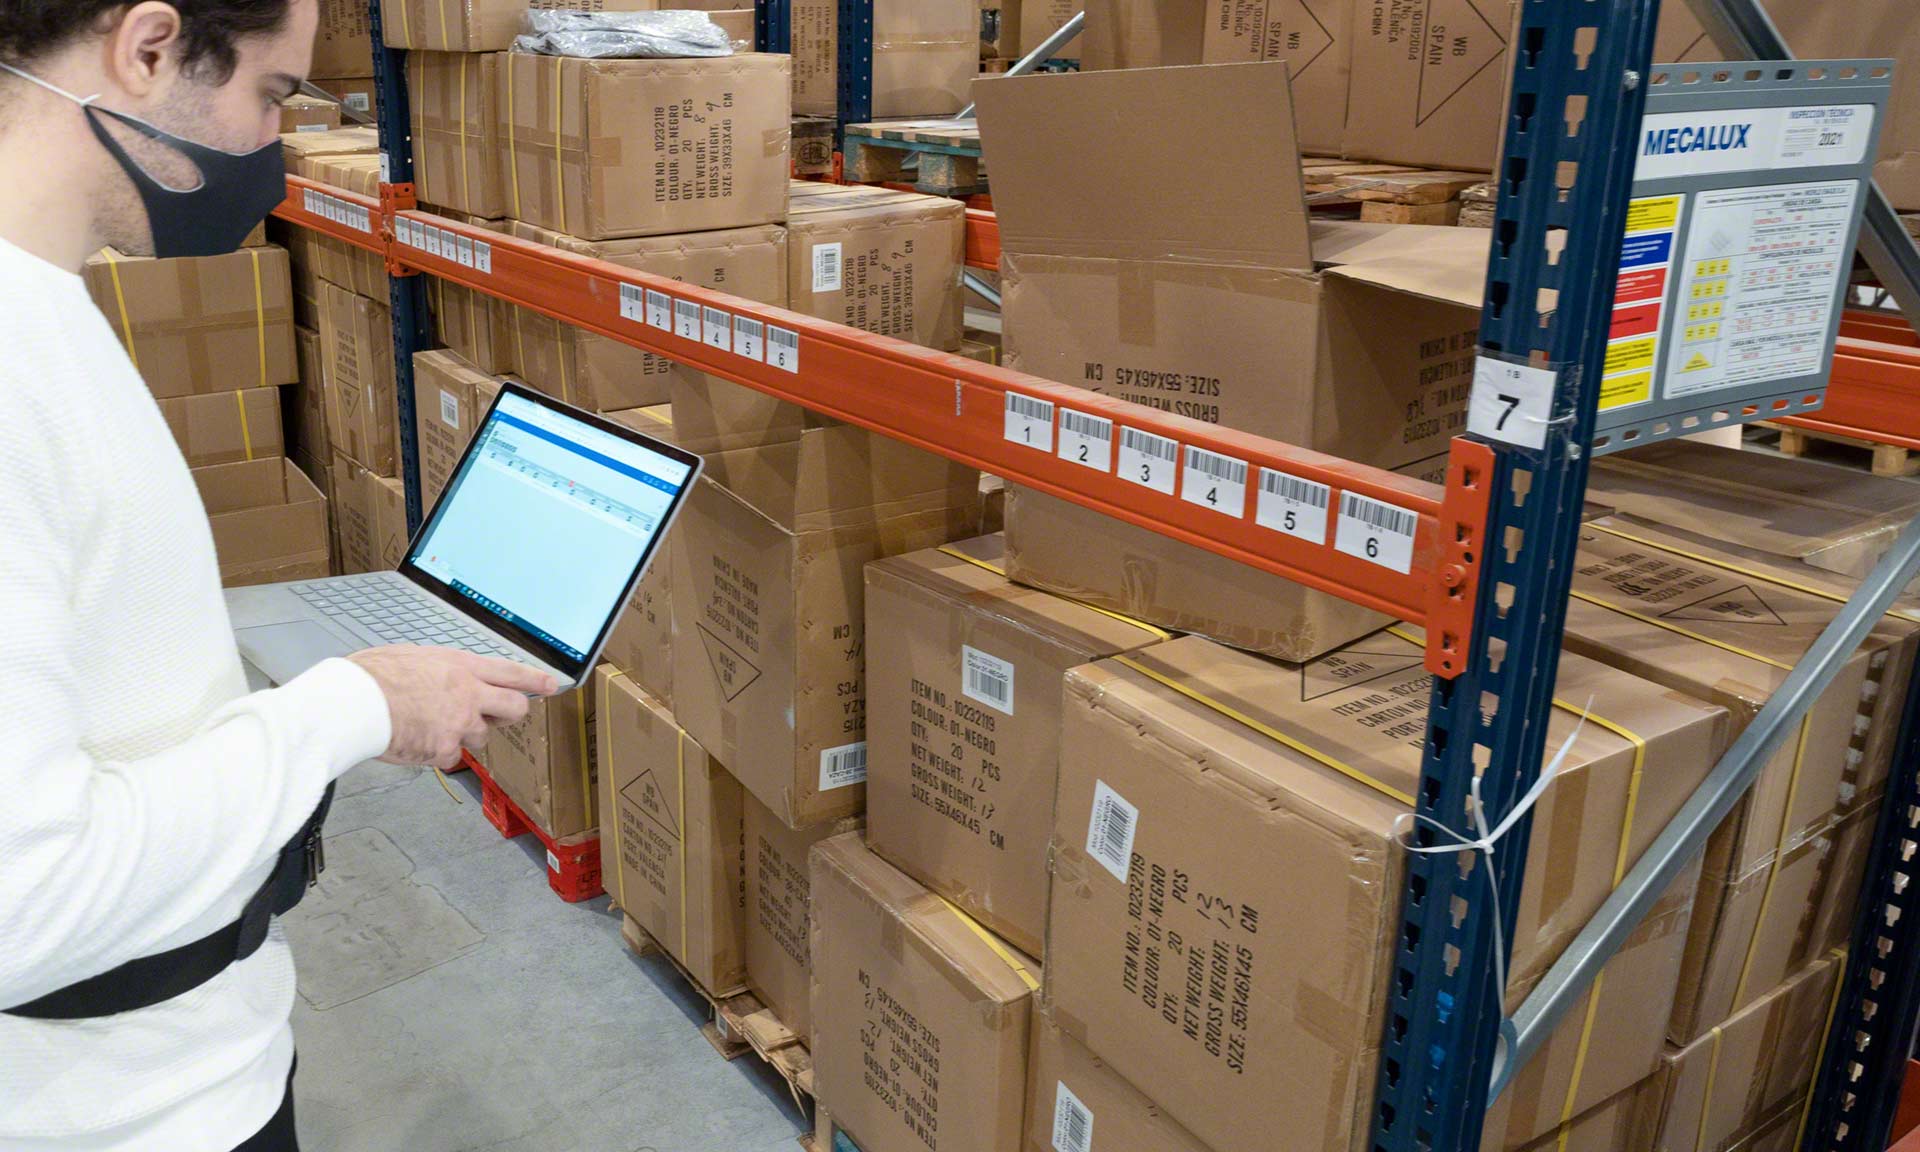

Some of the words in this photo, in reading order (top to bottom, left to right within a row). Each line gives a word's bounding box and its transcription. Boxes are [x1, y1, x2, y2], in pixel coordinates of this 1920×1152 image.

[1267, 22, 1282, 58] SPAIN
[1288, 32, 1300, 50] WB
[1429, 26, 1446, 66] SPAIN
[1453, 36, 1468, 56] WB
[682, 98, 692, 118] PCS
[723, 92, 733, 108] CM
[654, 106, 665, 152] 10232118
[668, 104, 679, 154] 01-NEGRO
[1643, 124, 1752, 156] MECALUX
[682, 140, 692, 152] 20
[656, 178, 665, 202] ITEM
[696, 180, 706, 199] NET
[708, 166, 720, 198] GROSS
[870, 248, 879, 266] PCS
[905, 240, 913, 254] CM
[714, 268, 724, 282] CM
[869, 284, 878, 296] 20
[628, 306, 634, 318] 1
[656, 314, 661, 326] 2
[892, 303, 902, 334] GROSS
[685, 324, 690, 336] 3
[714, 332, 720, 344] 4
[881, 320, 890, 336] NET
[745, 342, 750, 355] 5
[778, 352, 785, 366] 6
[1084, 362, 1103, 381] CM
[1116, 368, 1181, 391] 55X46X45
[1185, 376, 1220, 396] SIZE:
[1494, 393, 1520, 430] 7
[1024, 426, 1031, 443] 1
[1079, 444, 1088, 462] 2
[1141, 464, 1150, 482] 3
[1206, 488, 1218, 506] 4
[1284, 510, 1296, 530] 5
[1366, 538, 1378, 558] 6
[833, 624, 850, 640] CM
[1330, 662, 1375, 679] SPAIN
[838, 681, 858, 696] PCS
[912, 678, 932, 700] ITEM
[954, 700, 996, 732] 10232119
[1331, 700, 1372, 716] ITEM
[1356, 704, 1410, 728] CARTON
[912, 700, 948, 732] COLOUR:
[950, 720, 996, 756] 01-NEGRO
[912, 721, 928, 742] QTY:
[951, 742, 964, 760] 20
[982, 759, 1000, 782] PCS
[912, 742, 928, 762] NET
[928, 751, 964, 784] WEIGHT:
[912, 762, 940, 790] GROSS
[941, 780, 976, 813] WEIGHT:
[912, 784, 934, 808] SIZE:
[934, 796, 980, 834] 55X46X45
[990, 829, 1004, 851] CM
[1128, 852, 1146, 921] 10232119
[1172, 868, 1188, 904] PCS
[1146, 864, 1166, 942] 01-NEGRO
[1196, 892, 1214, 920] 12
[1215, 896, 1234, 930] 13
[1240, 904, 1259, 934] CM
[1126, 924, 1142, 957] NO.:
[1168, 930, 1183, 956] 20
[858, 968, 870, 988] CM
[1122, 954, 1138, 994] ITEM
[1142, 946, 1160, 1010] COLOUR:
[1186, 946, 1206, 1008] WEIGHT:
[1208, 939, 1230, 1004] WEIGHT:
[1230, 944, 1254, 1031] 55X46X45
[1162, 992, 1179, 1025] QTY:
[1183, 1006, 1200, 1042] NET
[1204, 1002, 1224, 1058] GROSS
[860, 1028, 874, 1052] PCS
[912, 1038, 939, 1072] GROSS
[1226, 1033, 1246, 1074] SIZE:
[864, 1052, 901, 1097] 01-NEGRO
[890, 1058, 900, 1076] 20
[922, 1068, 938, 1094] NET
[917, 1123, 936, 1152] ITEM
